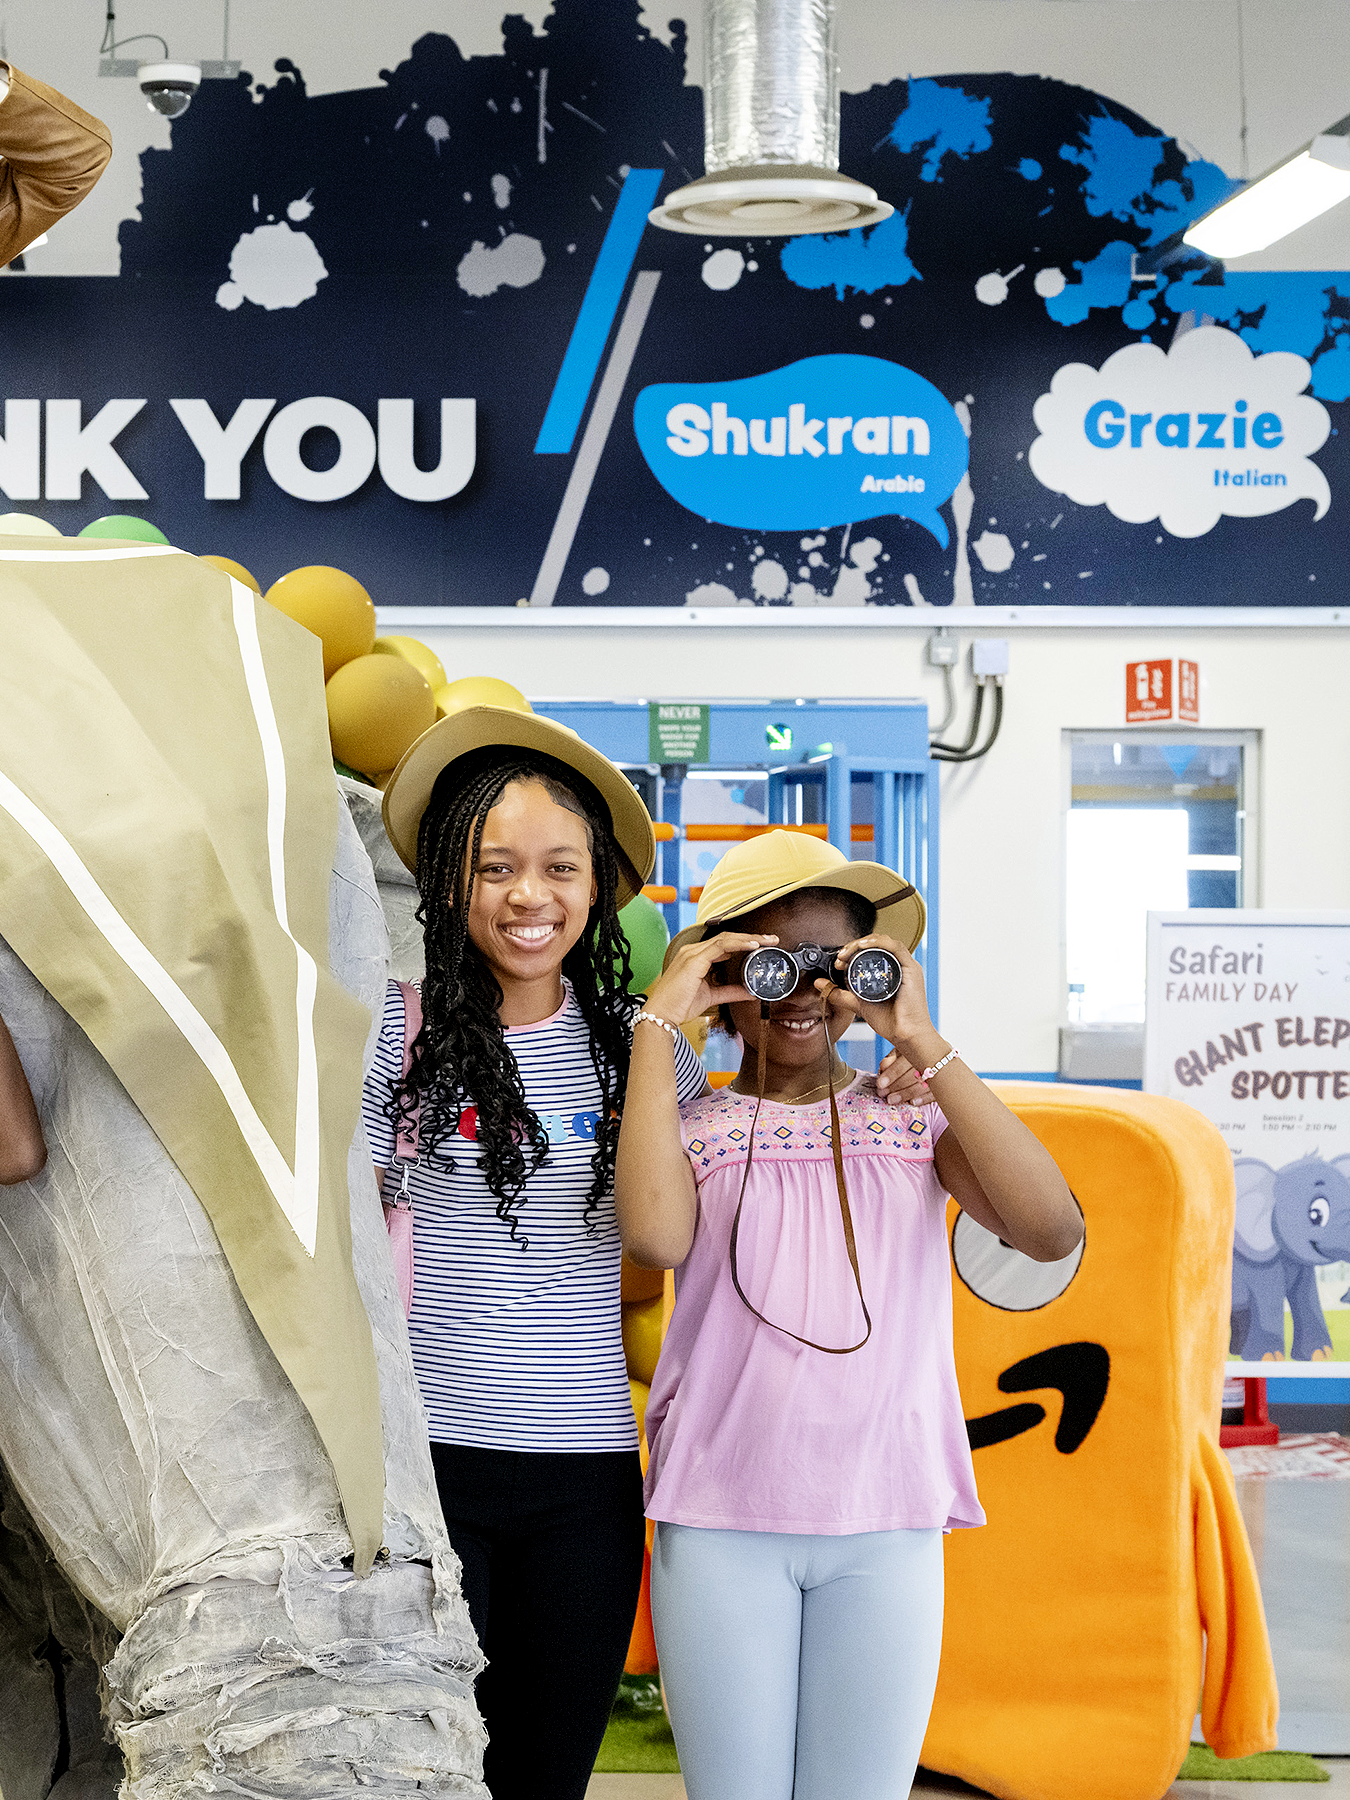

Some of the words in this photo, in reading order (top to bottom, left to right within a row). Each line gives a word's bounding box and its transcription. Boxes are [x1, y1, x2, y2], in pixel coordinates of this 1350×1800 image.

[666, 402, 930, 458] Shukran
[1084, 399, 1285, 449] Grazie
[168, 396, 477, 501] YOU
[860, 475, 925, 493] Arabic
[1214, 469, 1287, 487] Italian
[658, 706, 701, 719] NEVER
[1168, 942, 1264, 975] Safari
[1165, 982, 1246, 1002] FAMILY
[1253, 982, 1299, 1002] DAY
[1174, 1022, 1264, 1087] GIANT
[1275, 1016, 1350, 1048] ELEP
[1230, 1070, 1350, 1100] SPOTTE
